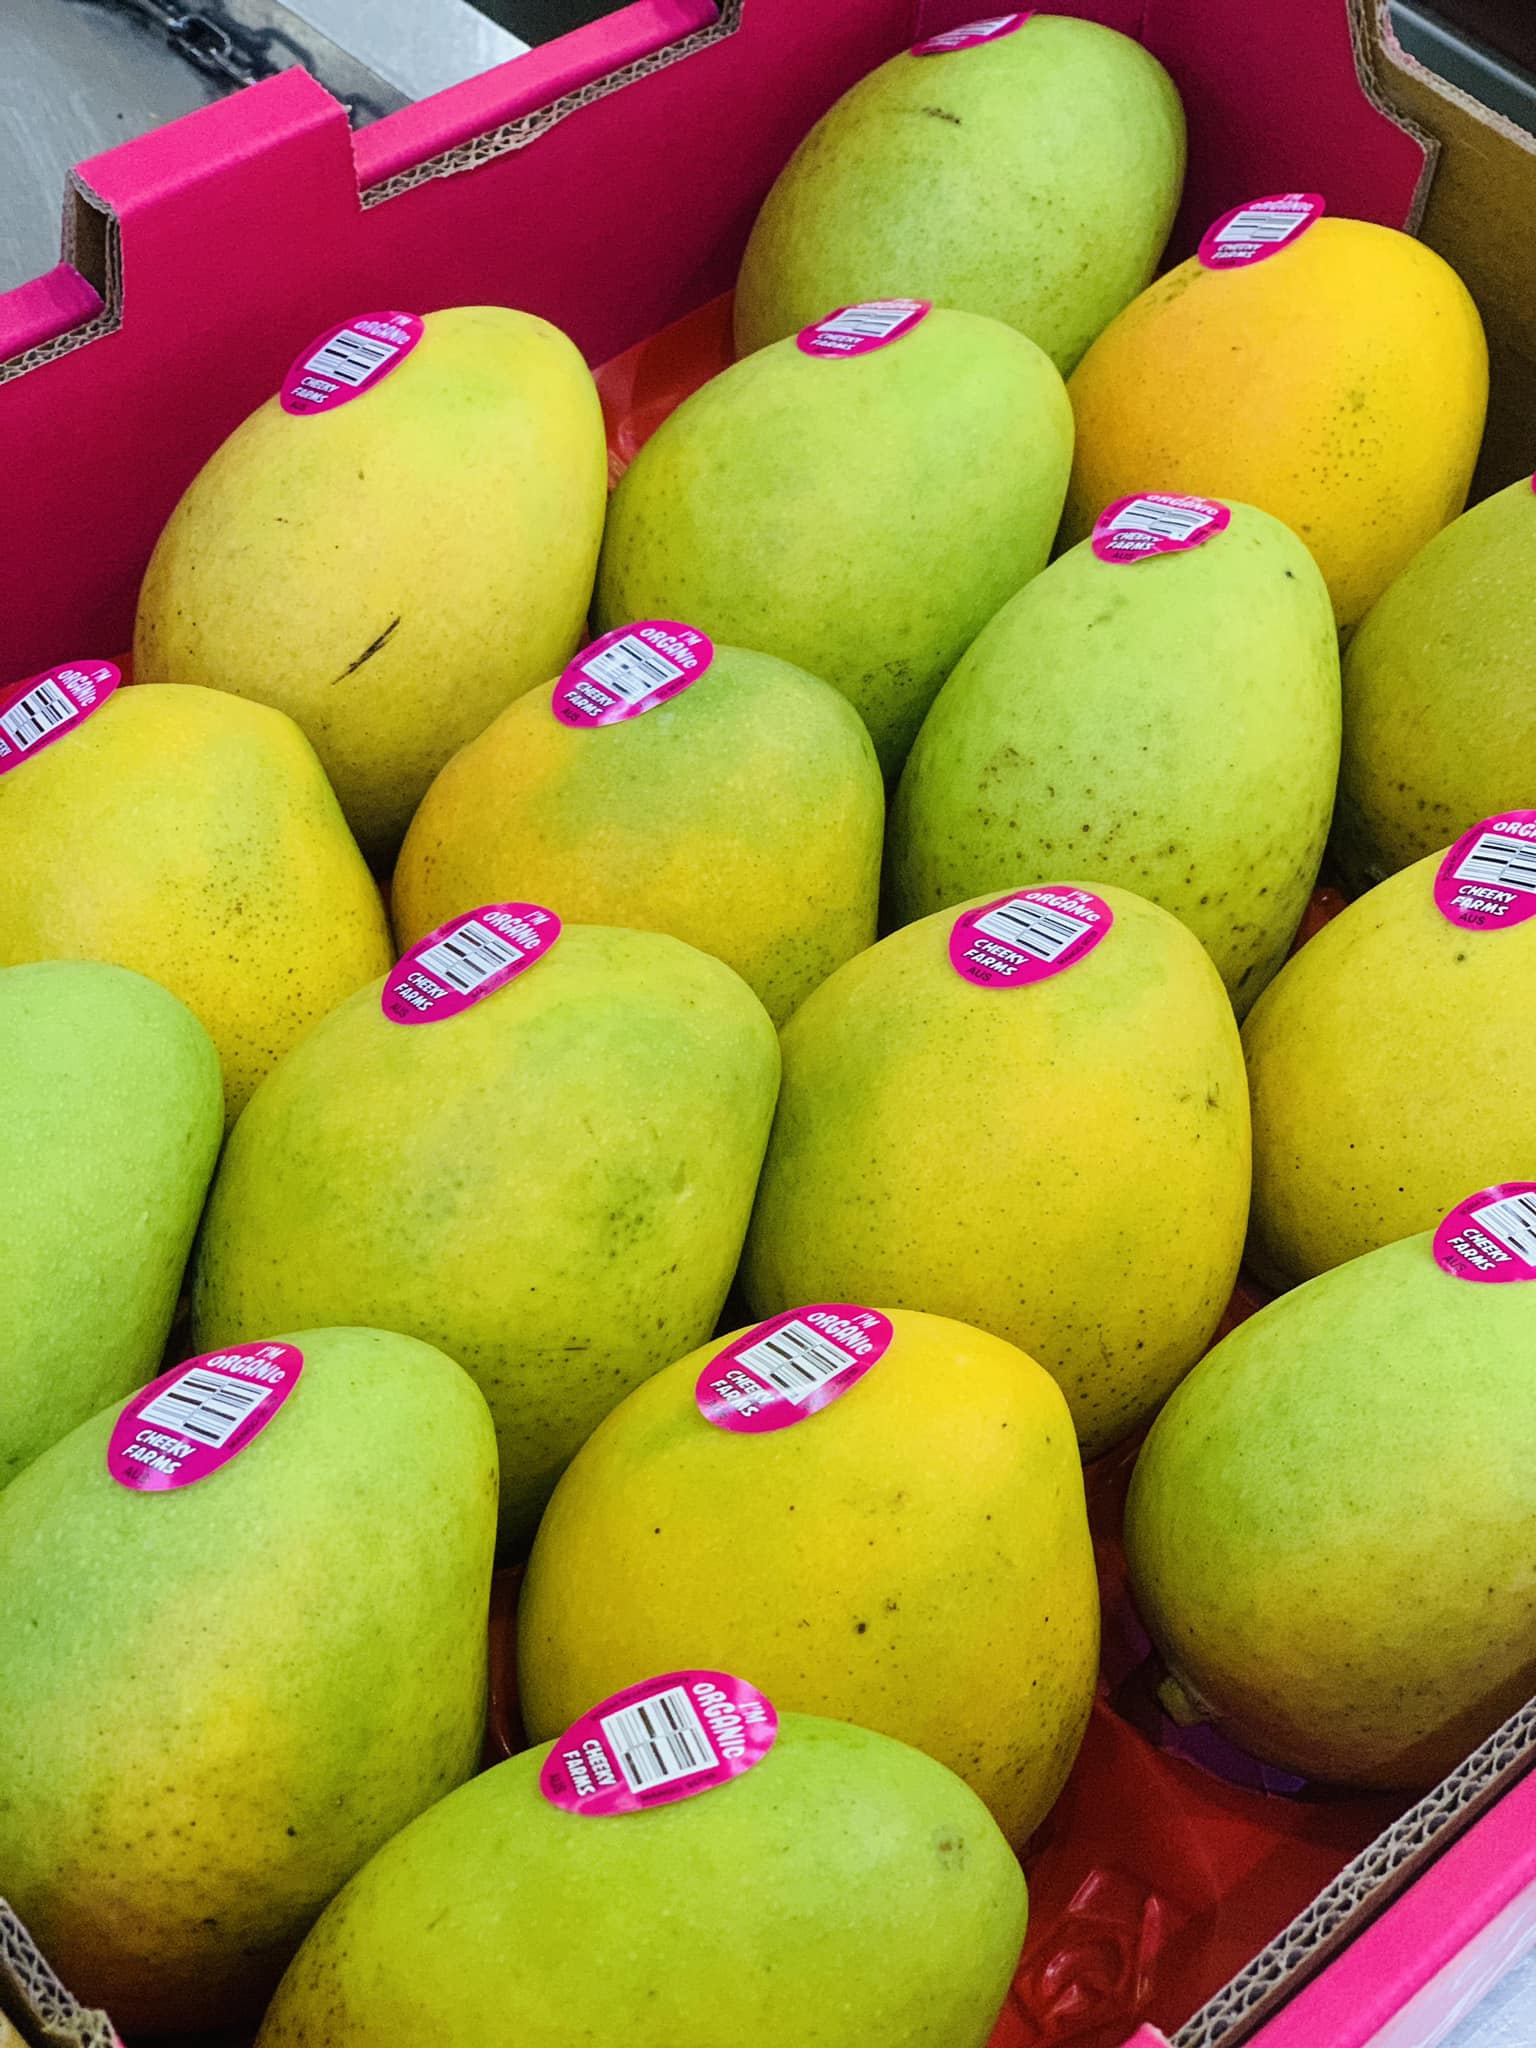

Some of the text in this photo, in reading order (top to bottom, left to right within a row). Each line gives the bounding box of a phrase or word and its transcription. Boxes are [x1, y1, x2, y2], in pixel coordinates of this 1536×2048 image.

[354, 320, 411, 345] ORGANIC
[290, 386, 329, 404] FARMS
[300, 376, 341, 394] CHEEKY
[1105, 541, 1157, 551] FARMS
[1112, 531, 1165, 543] CHEEKY
[639, 627, 698, 669] ORGANIC
[678, 630, 703, 647] I'M
[57, 669, 97, 707] ORGANIC
[575, 681, 617, 708] CHEEKY
[563, 690, 604, 718] FARMS
[1025, 891, 1102, 923] ORGANIC
[1068, 889, 1095, 904] I'M
[1450, 895, 1510, 917] FARMS
[1458, 885, 1518, 904] CHEEKY
[482, 911, 542, 950] ORGANIC
[523, 910, 551, 927] I'M
[1459, 913, 1486, 926] AUS
[963, 949, 1019, 977] FARMS
[973, 938, 1030, 966] CHEEKY
[407, 972, 449, 1000] CHEEKY
[966, 966, 993, 983] AUS
[393, 983, 435, 1012] FARMS
[1446, 1236, 1497, 1272] FARMS
[1463, 1228, 1513, 1263] CHEEKY
[807, 1312, 873, 1356] ORGANIC
[851, 1312, 881, 1330] I'M
[256, 1346, 287, 1361] I'M
[206, 1355, 286, 1384] ORGANIC
[709, 1379, 760, 1418] FARMS
[725, 1369, 776, 1406] CHEEKY
[135, 1429, 197, 1459] CHEEKY
[122, 1444, 182, 1475] FARMS
[693, 1682, 745, 1760] ORGANIC
[739, 1700, 768, 1725] I'M
[563, 1750, 597, 1798] FARMS
[582, 1739, 617, 1787] CHEEKY
